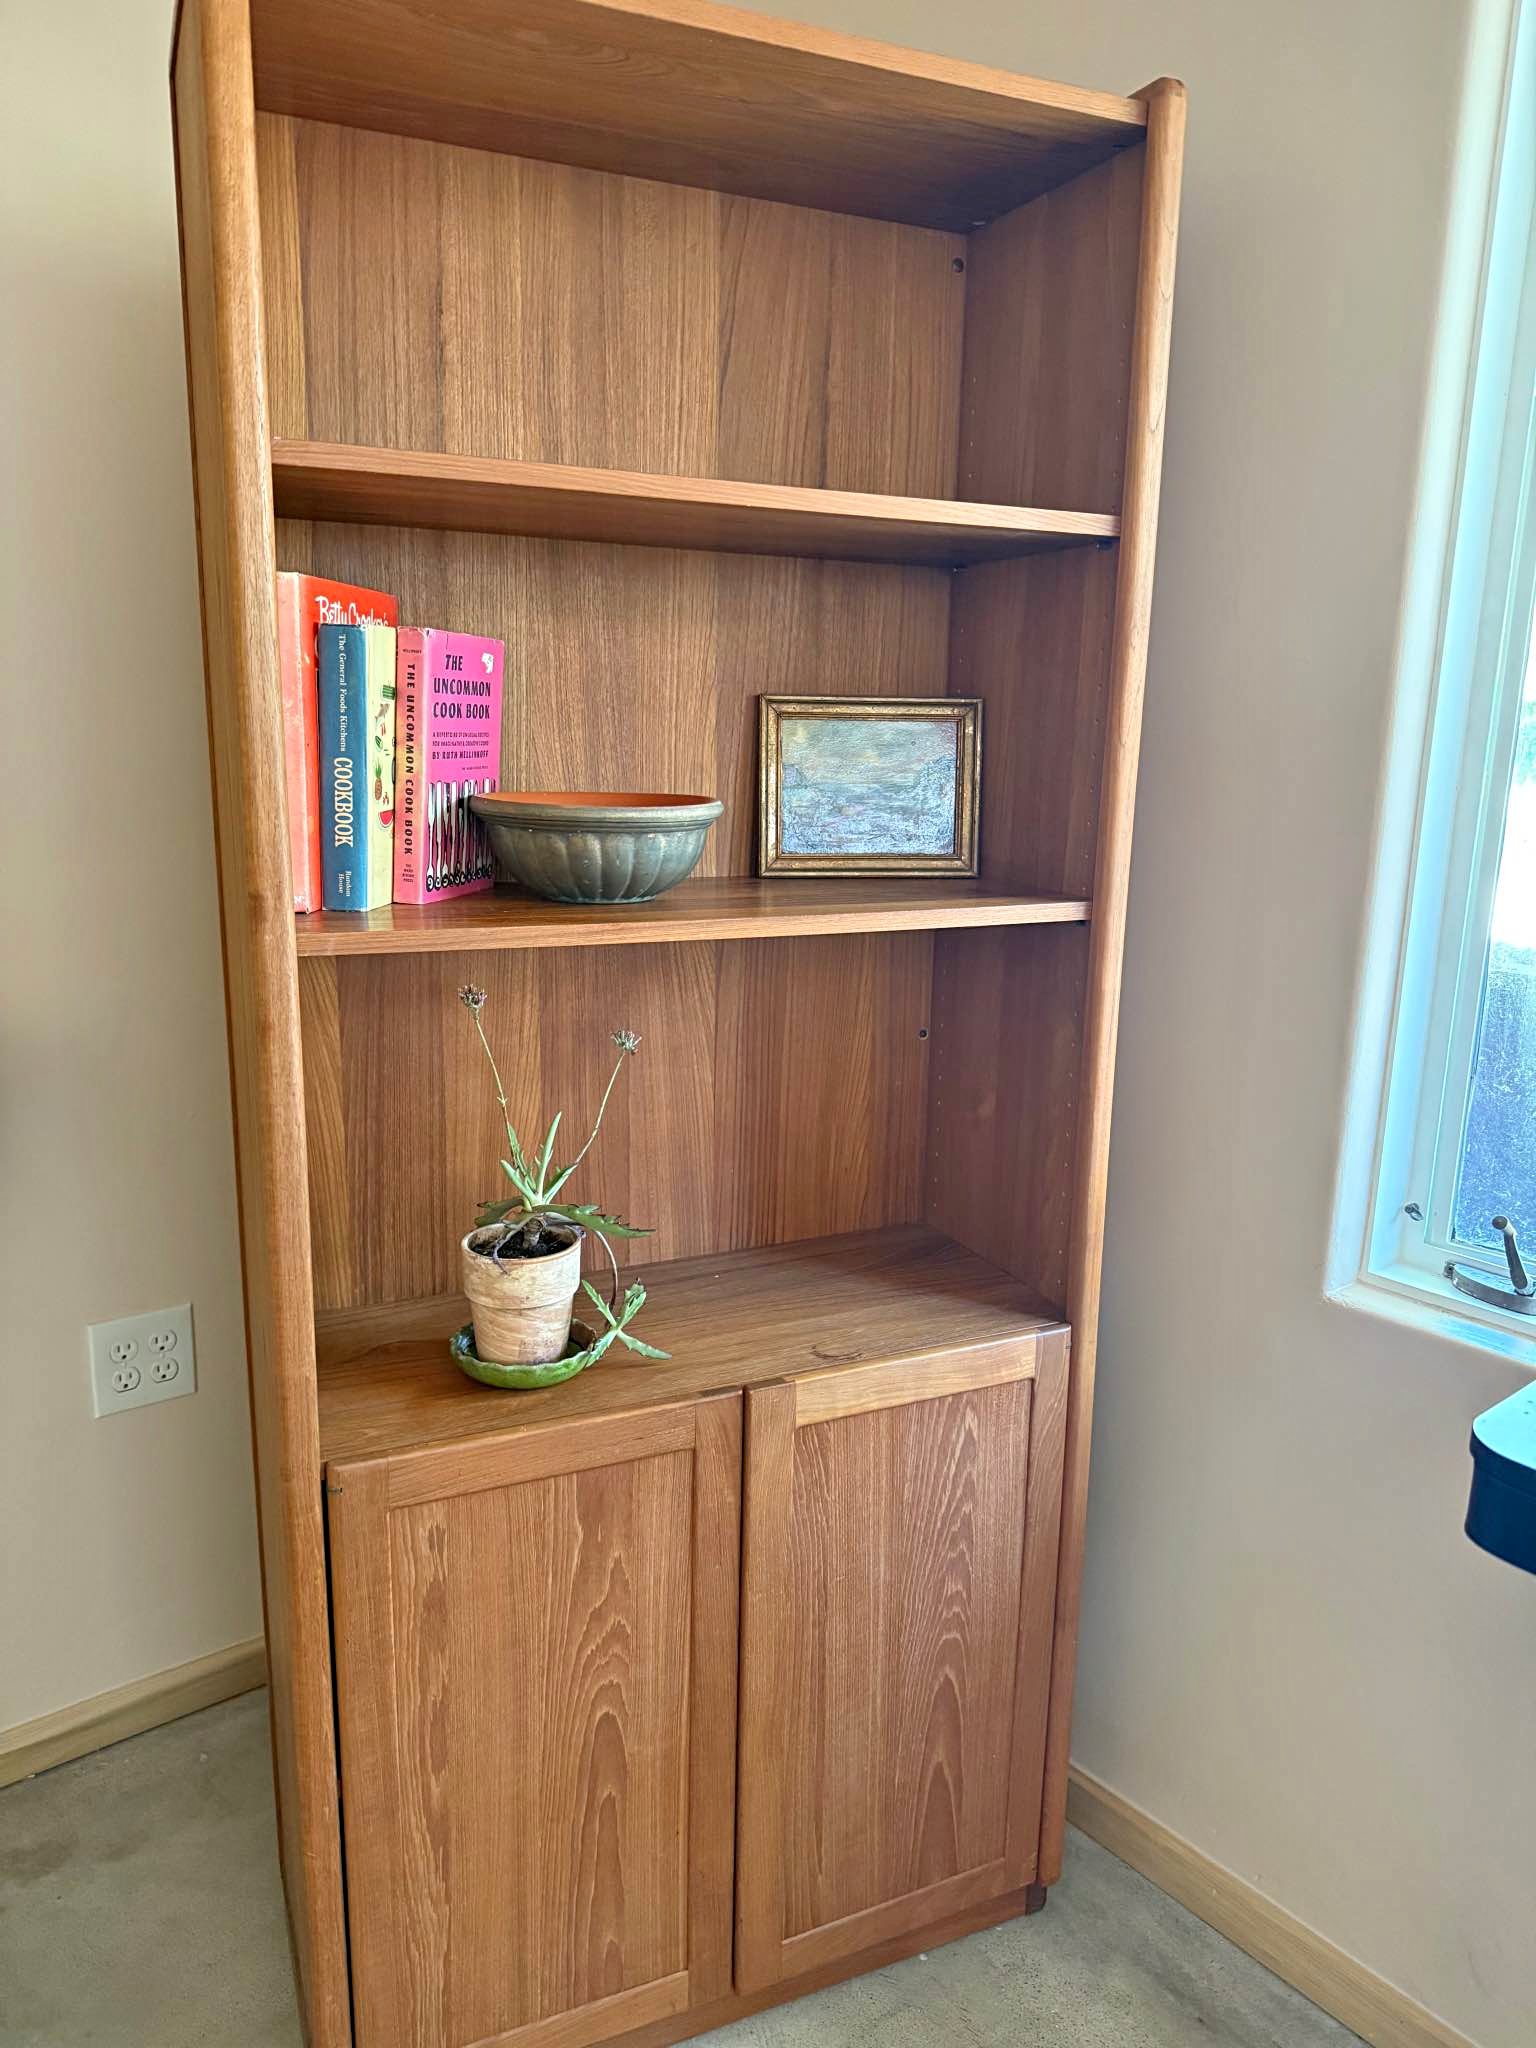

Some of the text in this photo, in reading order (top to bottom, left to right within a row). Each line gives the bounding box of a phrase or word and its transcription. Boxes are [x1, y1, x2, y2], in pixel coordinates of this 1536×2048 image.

[314, 595, 347, 625] Betty
[406, 664, 416, 689] THE
[445, 654, 463, 671] THE
[339, 634, 348, 752] The General Foods Kitchens
[433, 677, 491, 697] UNCOMMON
[432, 702, 490, 719] COOK BOOK
[405, 694, 416, 774] UNCOMMON
[432, 751, 440, 760] BY
[334, 757, 353, 848] COOKBOOK
[404, 779, 415, 814] COOK
[404, 820, 414, 855] BOOK
